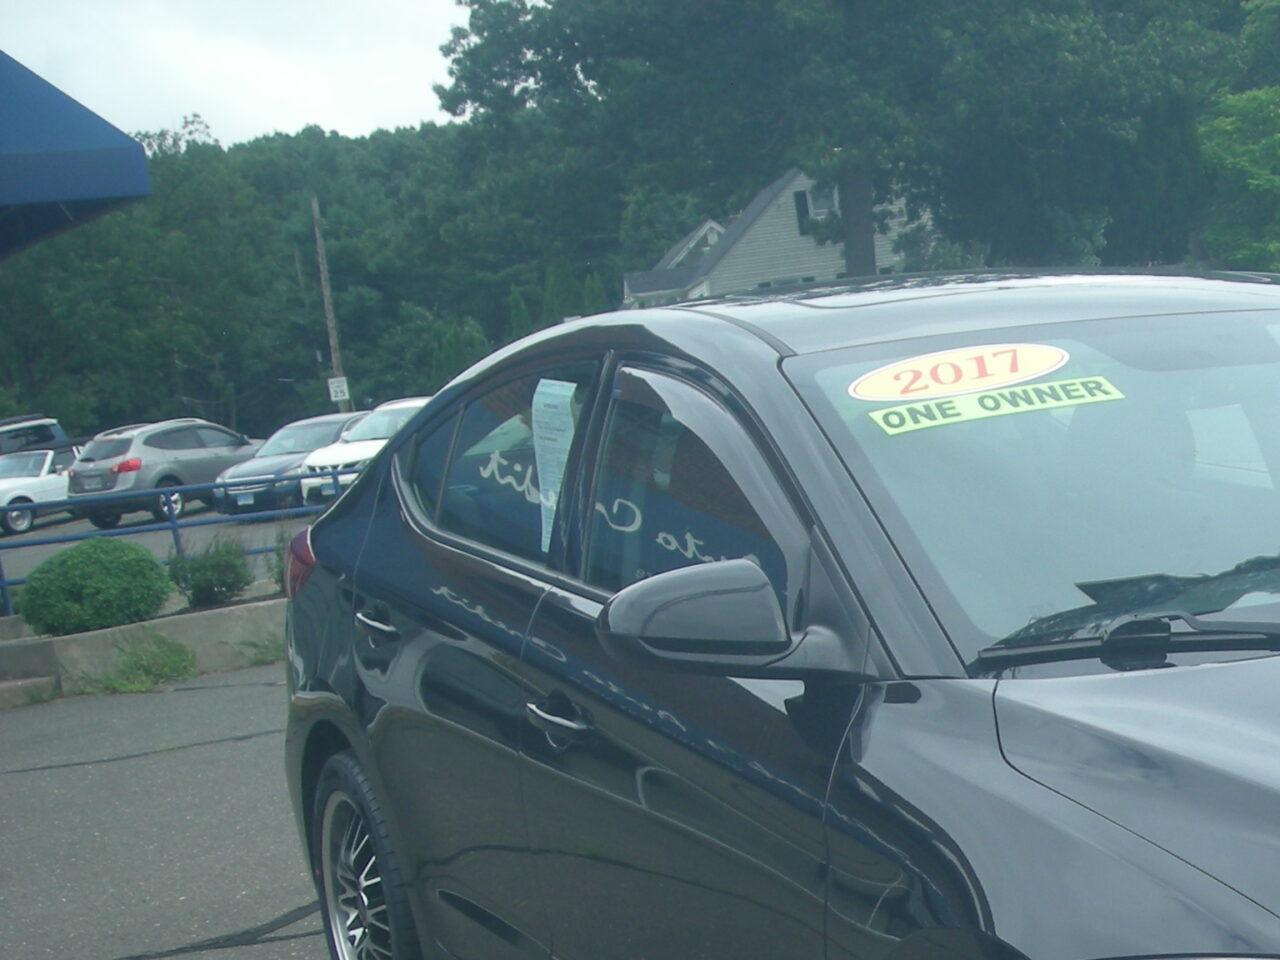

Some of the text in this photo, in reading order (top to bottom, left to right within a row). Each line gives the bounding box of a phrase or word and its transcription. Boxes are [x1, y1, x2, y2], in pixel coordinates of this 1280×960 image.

[893, 348, 1019, 395] 2017
[882, 380, 1112, 429] ONE OWNER
